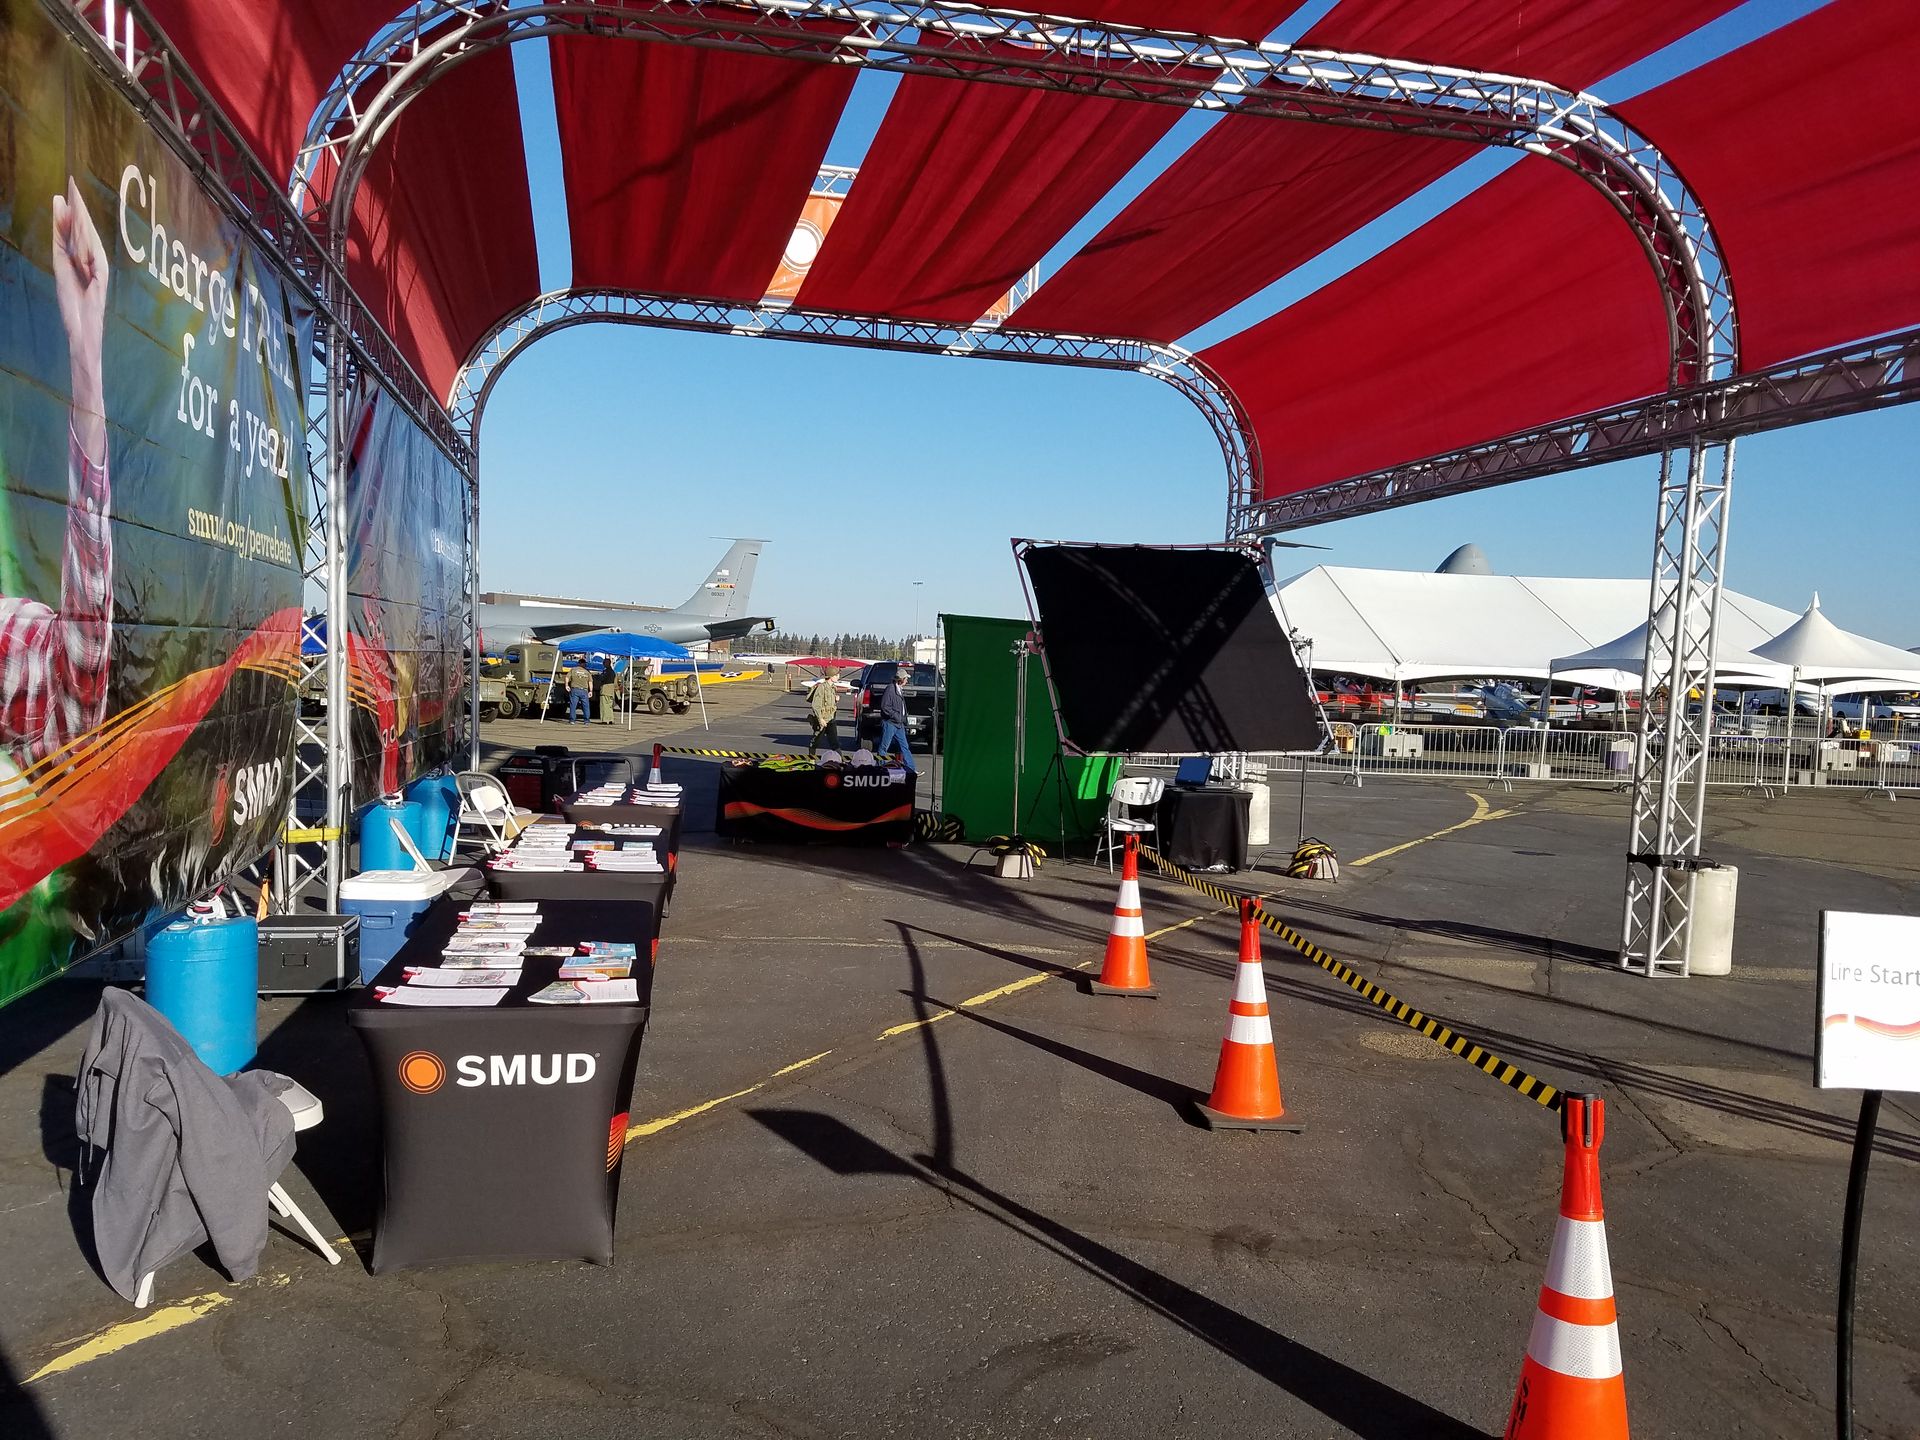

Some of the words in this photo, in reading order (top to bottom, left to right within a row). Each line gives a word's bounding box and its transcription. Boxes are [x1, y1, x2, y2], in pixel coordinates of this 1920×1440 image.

[119, 164, 236, 346] Charge
[178, 333, 218, 438] for
[230, 399, 240, 452] a
[188, 502, 292, 565] smud.org/pevrebate
[843, 775, 891, 787] SMUD
[456, 1053, 597, 1088] SMUD
